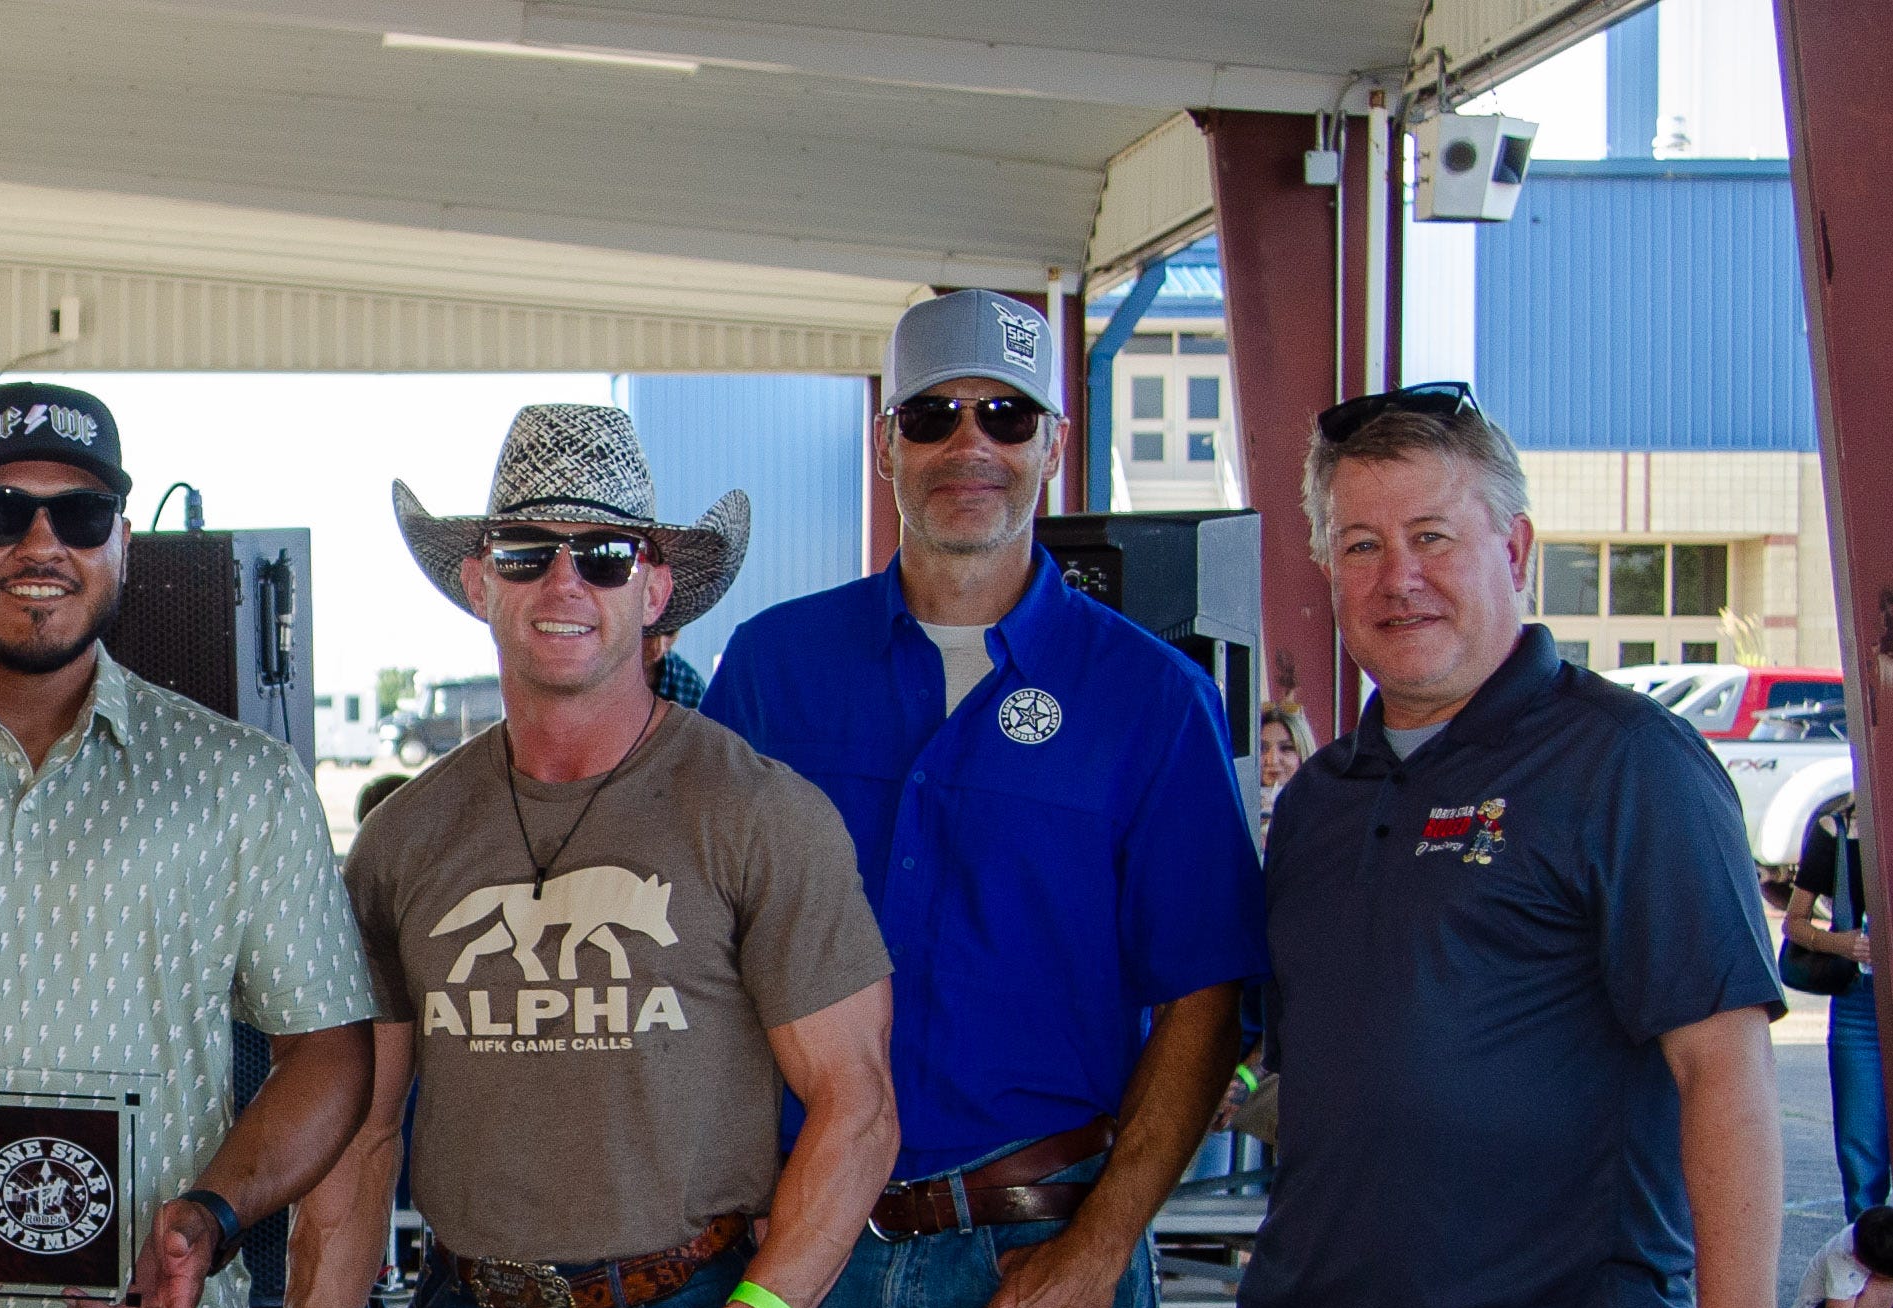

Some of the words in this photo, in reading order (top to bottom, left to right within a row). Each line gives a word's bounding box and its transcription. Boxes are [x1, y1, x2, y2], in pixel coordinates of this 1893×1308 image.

[1008, 325, 1033, 347] SPS
[1015, 691, 1035, 702] STAR
[1008, 727, 1043, 741] RODEO
[424, 986, 688, 1036] ALPHA
[469, 1040, 506, 1052] MFK
[511, 1039, 566, 1052] GAME
[571, 1037, 633, 1051] CALLS
[50, 1142, 107, 1194] STAR
[24, 1215, 66, 1225] RODEO
